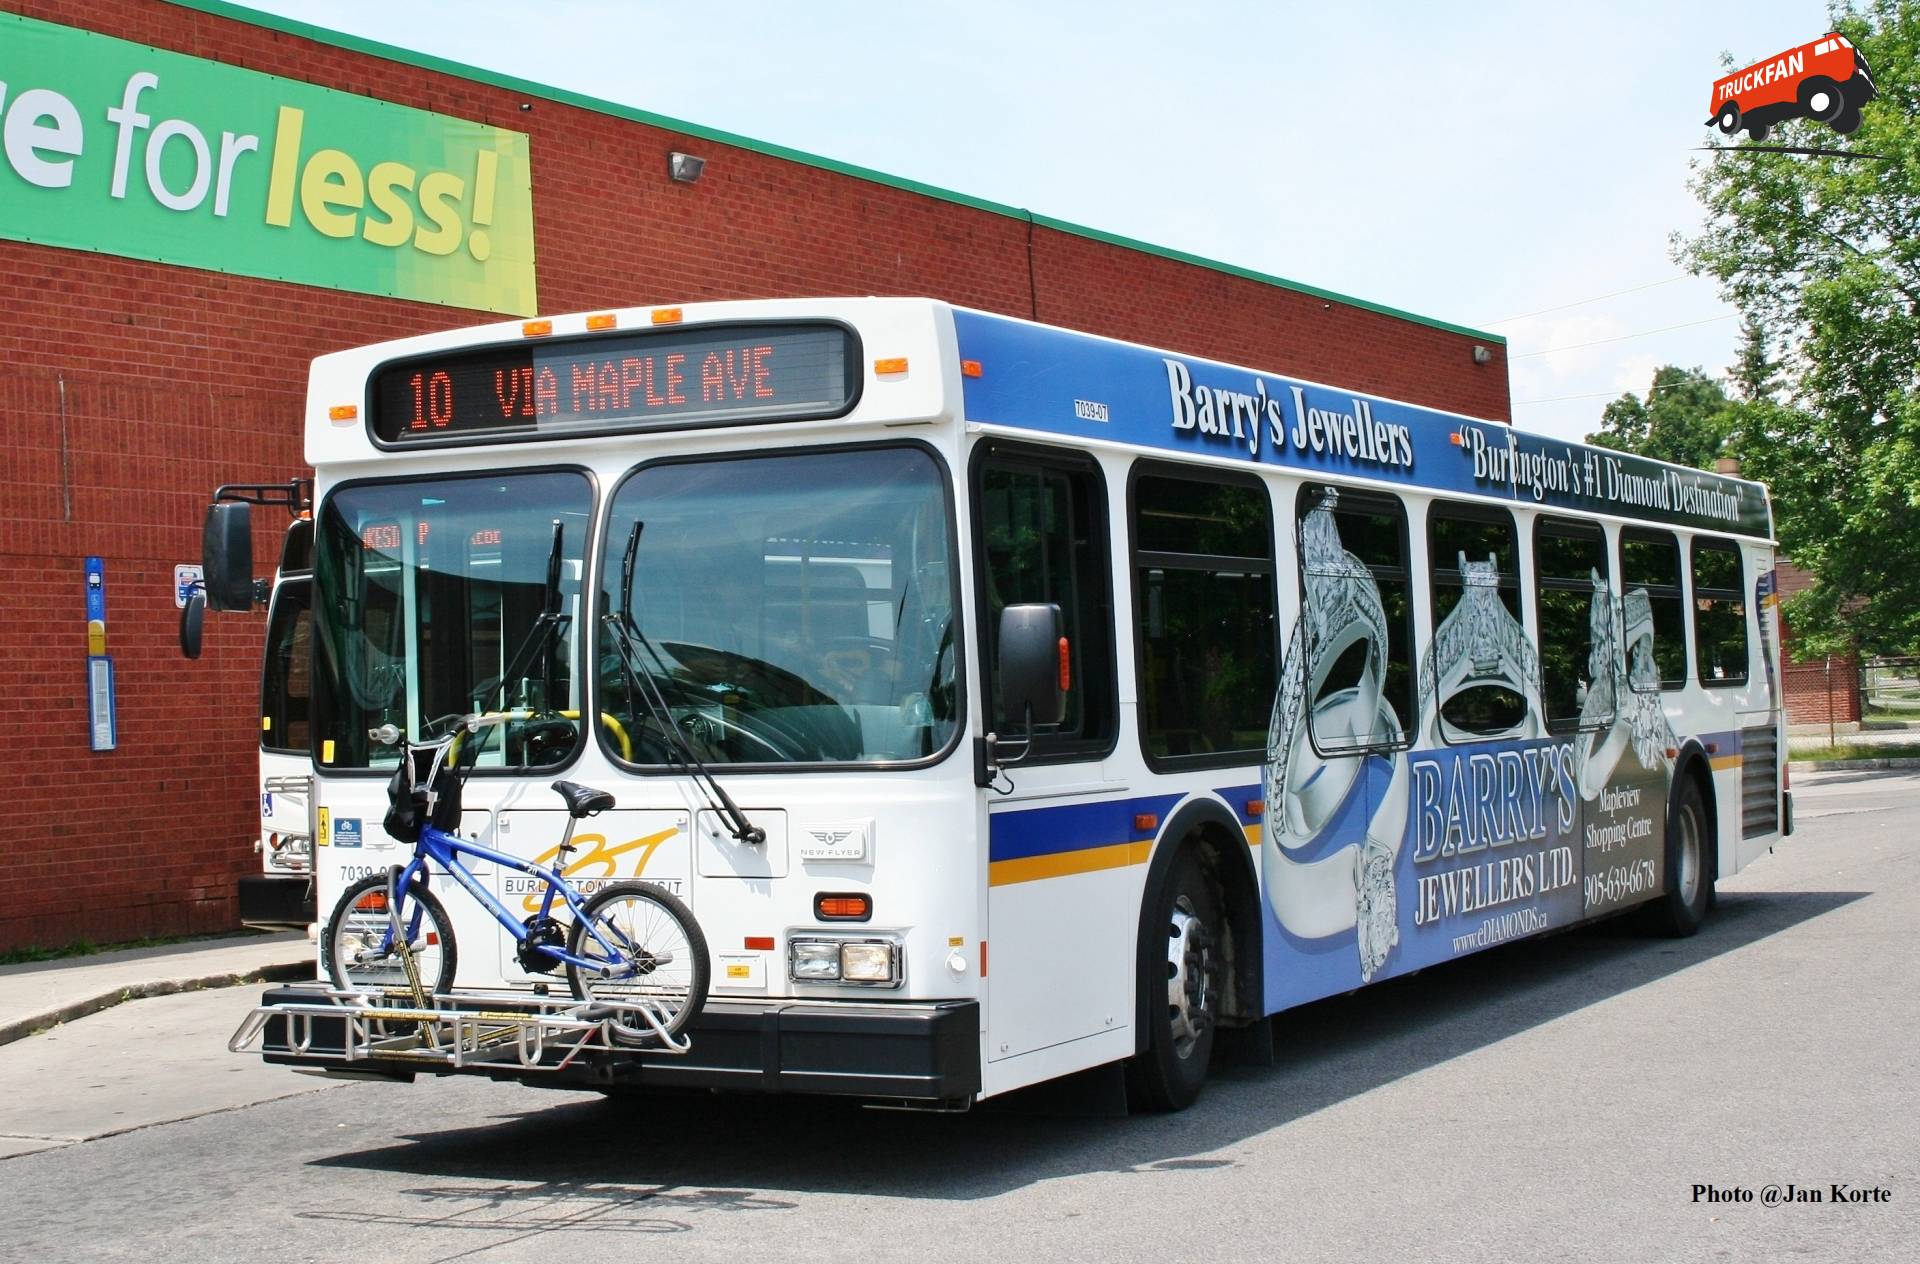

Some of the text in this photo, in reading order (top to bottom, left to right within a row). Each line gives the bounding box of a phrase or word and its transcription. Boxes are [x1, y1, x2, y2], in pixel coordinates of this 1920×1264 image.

[0, 72, 498, 262] e for less!
[409, 345, 776, 431] 10 VIA MAPLE AVE
[1075, 400, 1107, 420] 7039-07
[1162, 358, 1412, 467] Barry's Jewellers
[1584, 451, 1604, 499] #1
[1604, 456, 1670, 511] Diamond
[1413, 743, 1577, 863] BARRY'S
[1600, 785, 1640, 818] Mapleview
[1586, 816, 1652, 852] Shopping Centre
[1415, 846, 1577, 925] JEWELLERS LTD.
[1584, 859, 1655, 909] 905-639-6678
[1452, 907, 1547, 953] www.eDIAMONDS.ca
